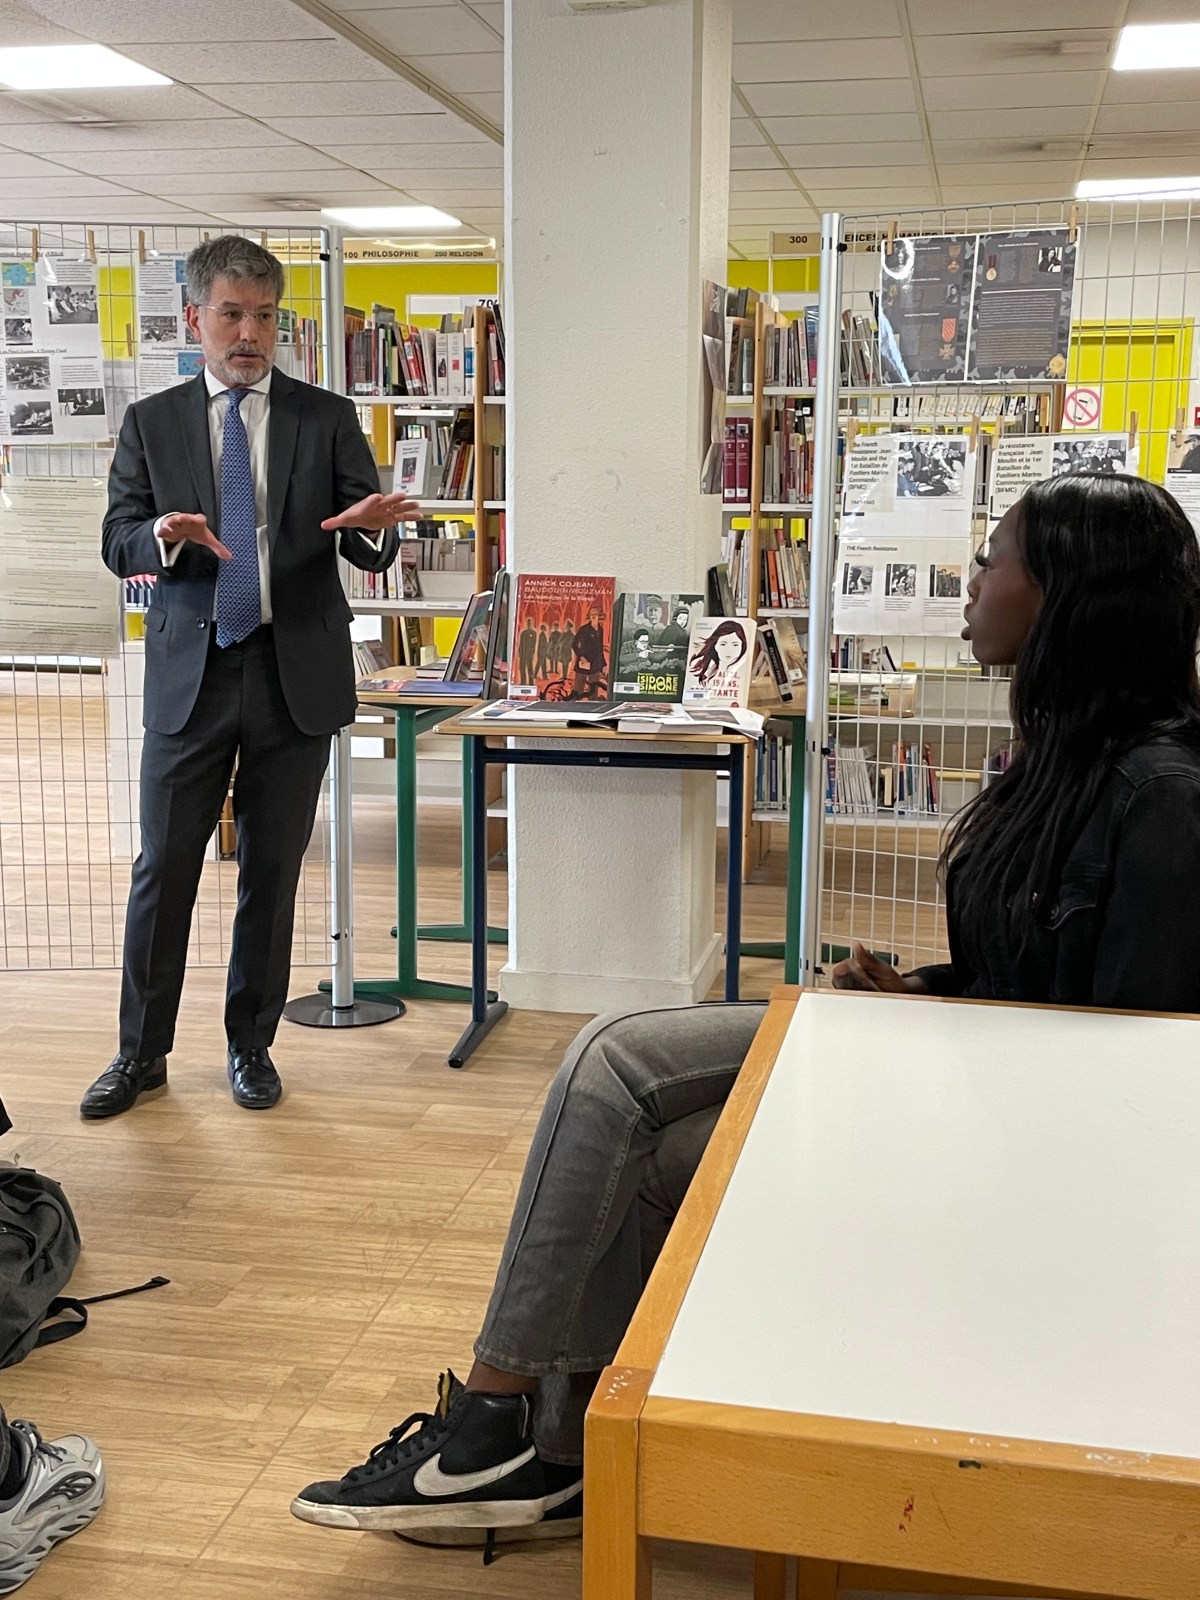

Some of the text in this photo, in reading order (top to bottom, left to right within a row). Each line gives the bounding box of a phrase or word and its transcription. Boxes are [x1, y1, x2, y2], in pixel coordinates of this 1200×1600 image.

[789, 235, 808, 244] 300
[845, 233, 876, 242] ENCES
[362, 250, 419, 258] PHILOSOPHIE
[637, 675, 679, 684] ISIDORE
[640, 683, 678, 692] SIMONE
